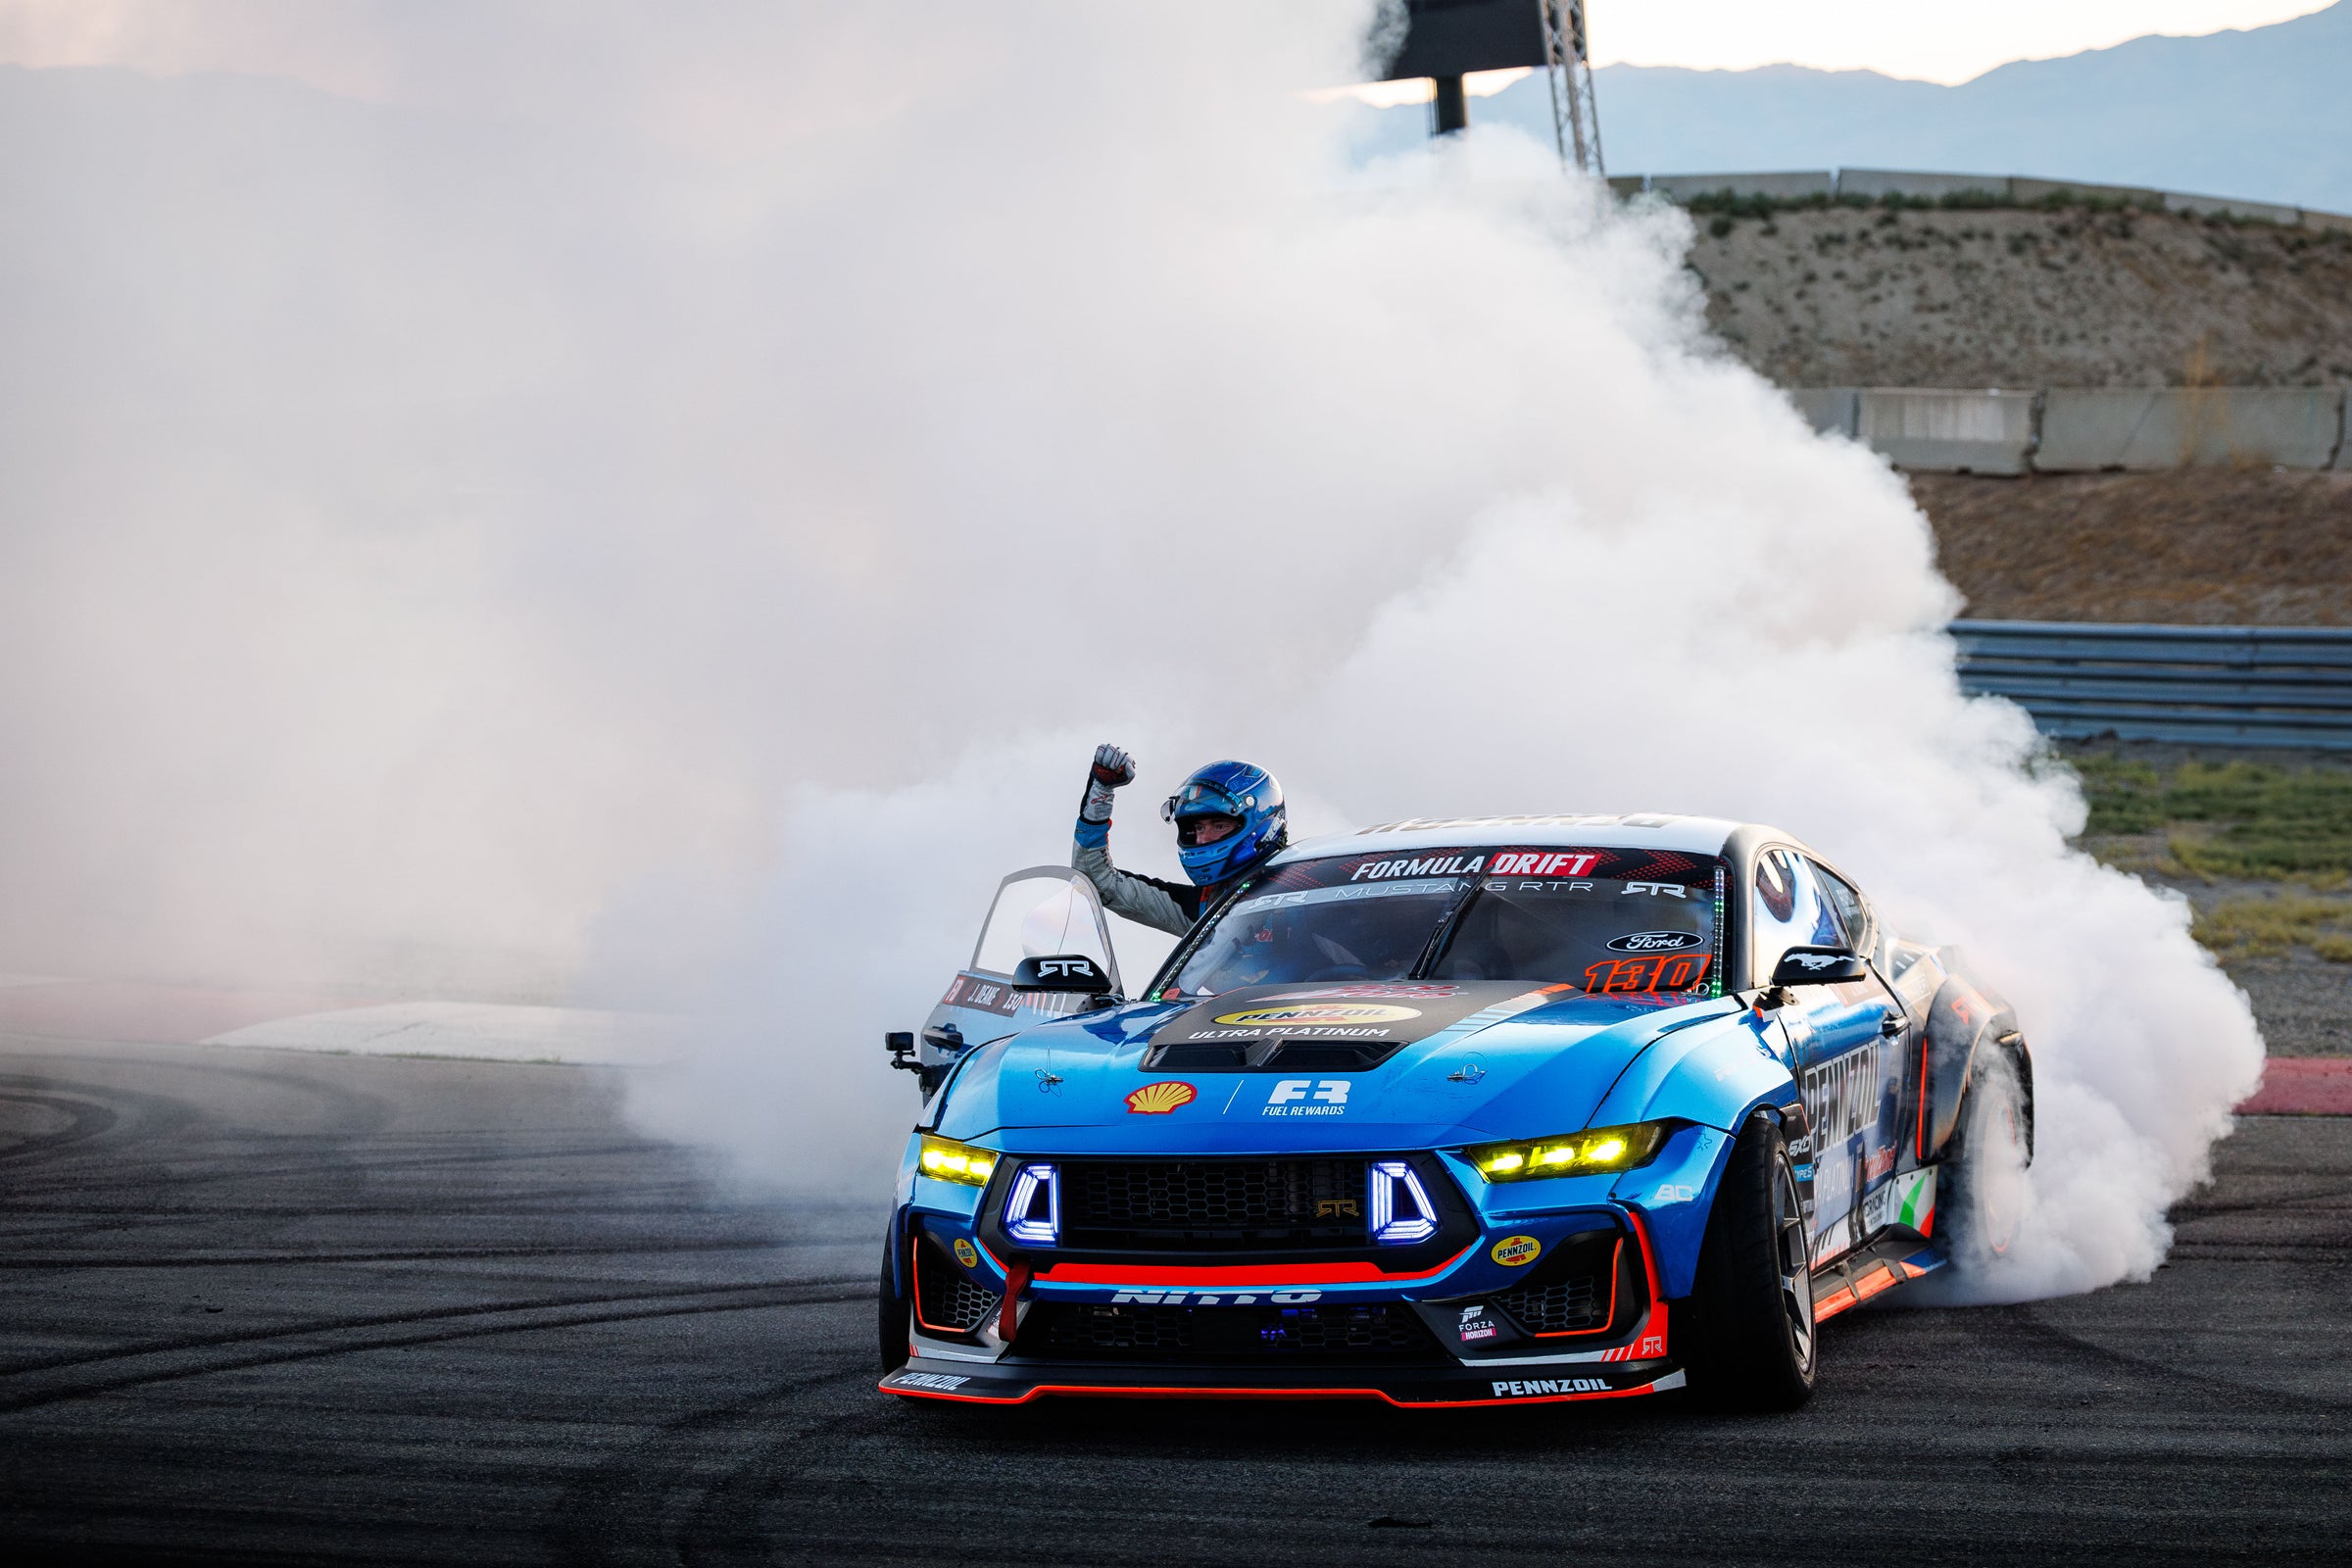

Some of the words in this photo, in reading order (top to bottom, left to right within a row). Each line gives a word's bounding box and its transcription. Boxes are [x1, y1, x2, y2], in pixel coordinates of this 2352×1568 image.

[1350, 856, 1486, 881] FORMULA
[1491, 854, 1595, 875] DRIFT
[1335, 882, 1507, 899] MUSTANG
[1519, 882, 1594, 892] RTR
[1625, 933, 1685, 950] Ford
[1585, 954, 1713, 994] 130
[1003, 993, 1024, 1010] 130
[1235, 1007, 1388, 1023] PENNZOIL
[1188, 1028, 1262, 1040] ULTRA
[1271, 1026, 1392, 1038] PLATINUM
[1804, 1039, 1882, 1158] PENNZOIL
[1262, 1105, 1288, 1116] FUEL
[1290, 1105, 1346, 1115] REWARDS
[1496, 1241, 1537, 1259] PENNZOIL
[1110, 1289, 1323, 1305] NITTO
[1458, 1320, 1495, 1332] FORZA
[1465, 1329, 1494, 1340] HORIZON
[892, 1372, 972, 1391] PENNZOIL
[1492, 1378, 1613, 1396] PENNZOIL
